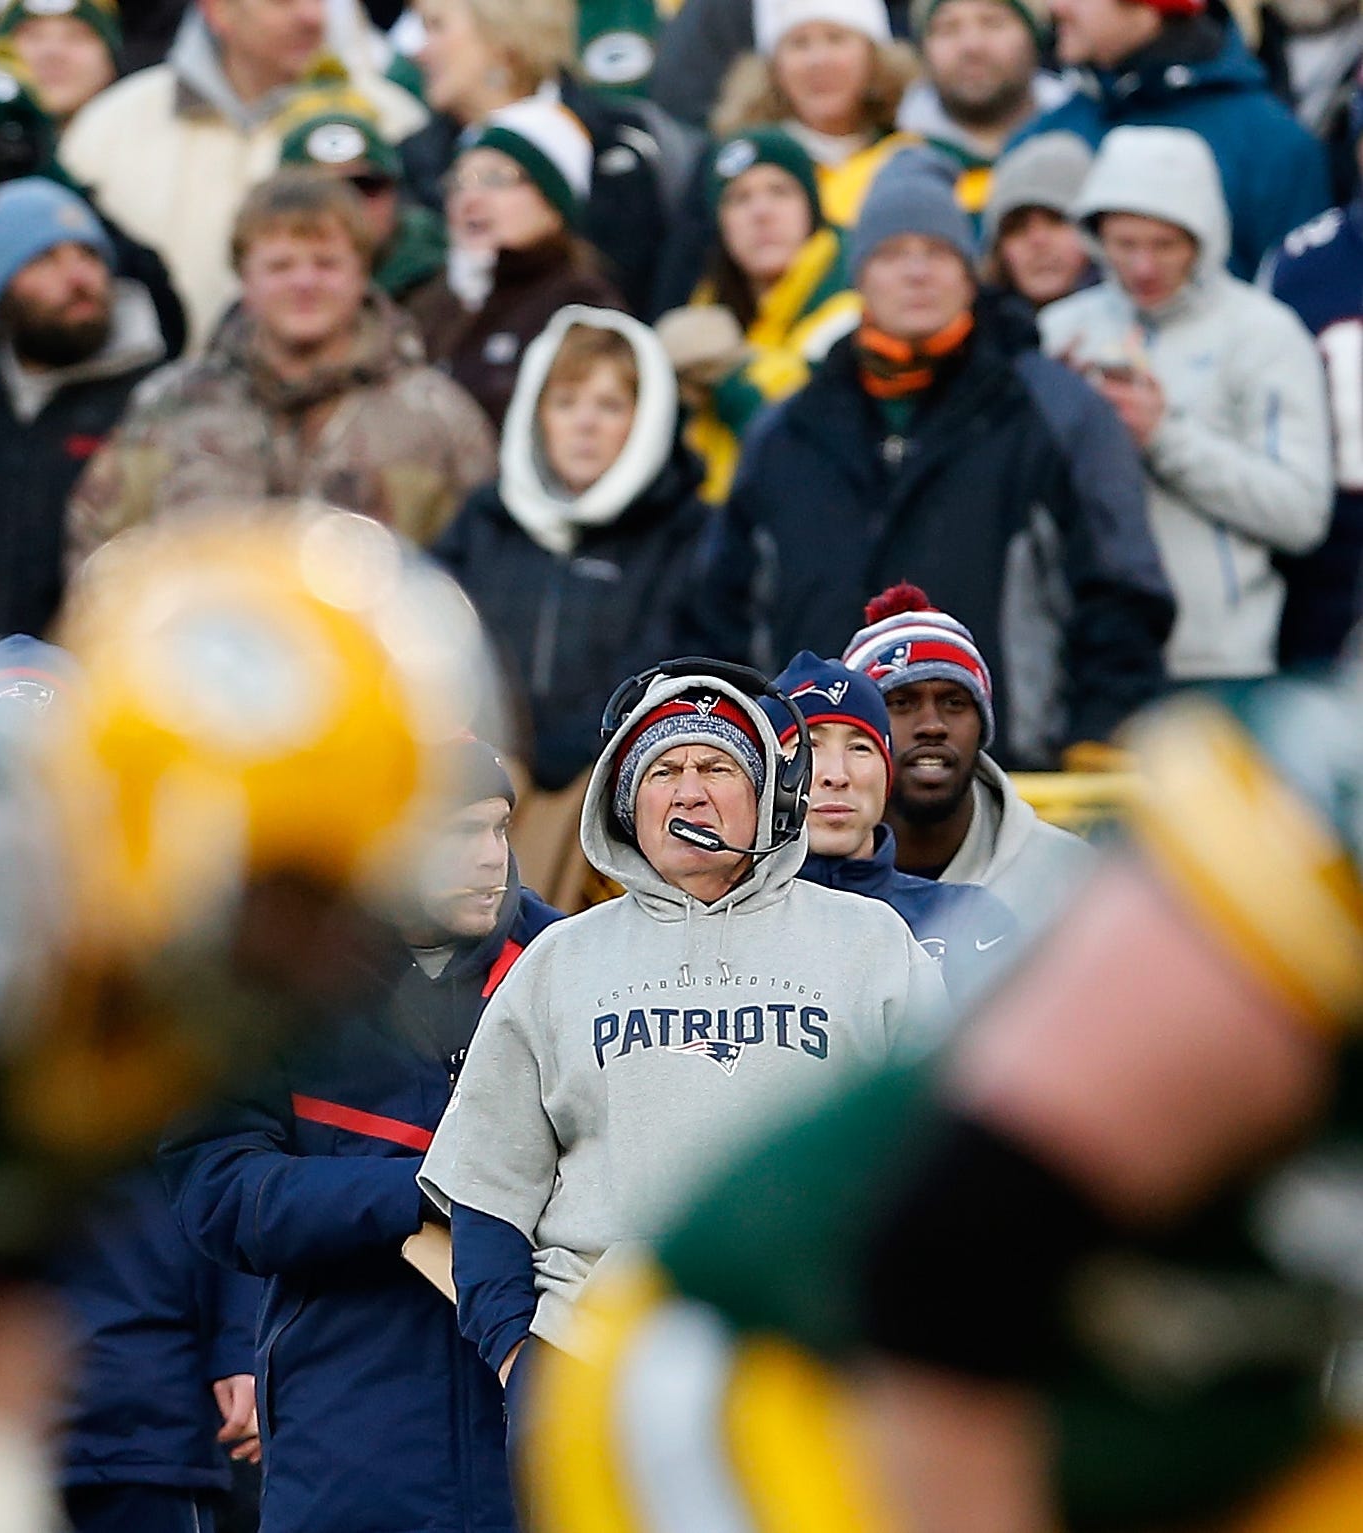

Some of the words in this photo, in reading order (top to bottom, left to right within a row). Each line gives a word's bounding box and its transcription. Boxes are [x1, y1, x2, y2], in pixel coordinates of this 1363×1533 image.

[597, 976, 758, 1007] ESTABLISHED
[770, 977, 822, 1000] 1960
[593, 1004, 829, 1069] PATRIOTS
